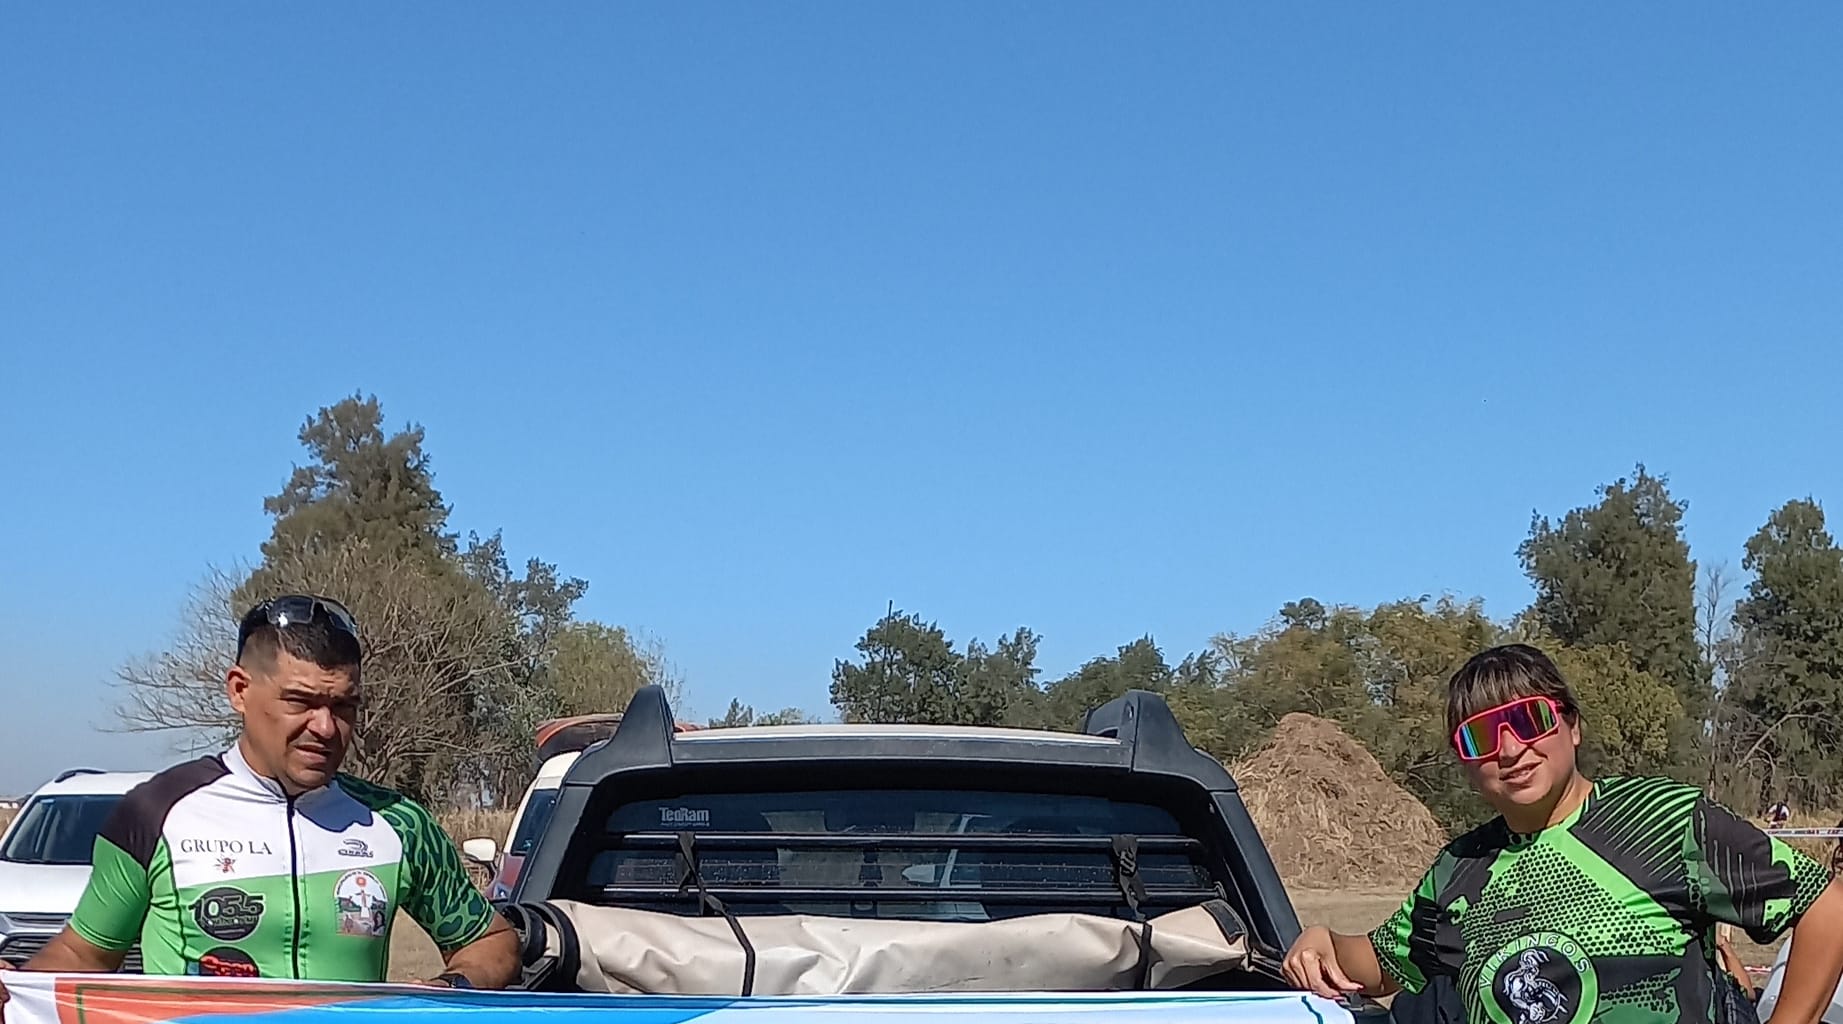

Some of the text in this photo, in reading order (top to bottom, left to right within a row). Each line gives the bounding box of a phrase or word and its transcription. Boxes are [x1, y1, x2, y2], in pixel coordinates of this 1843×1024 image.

[180, 839, 272, 855] GRUPO LA
[1479, 933, 1592, 988] VIKINGOS
